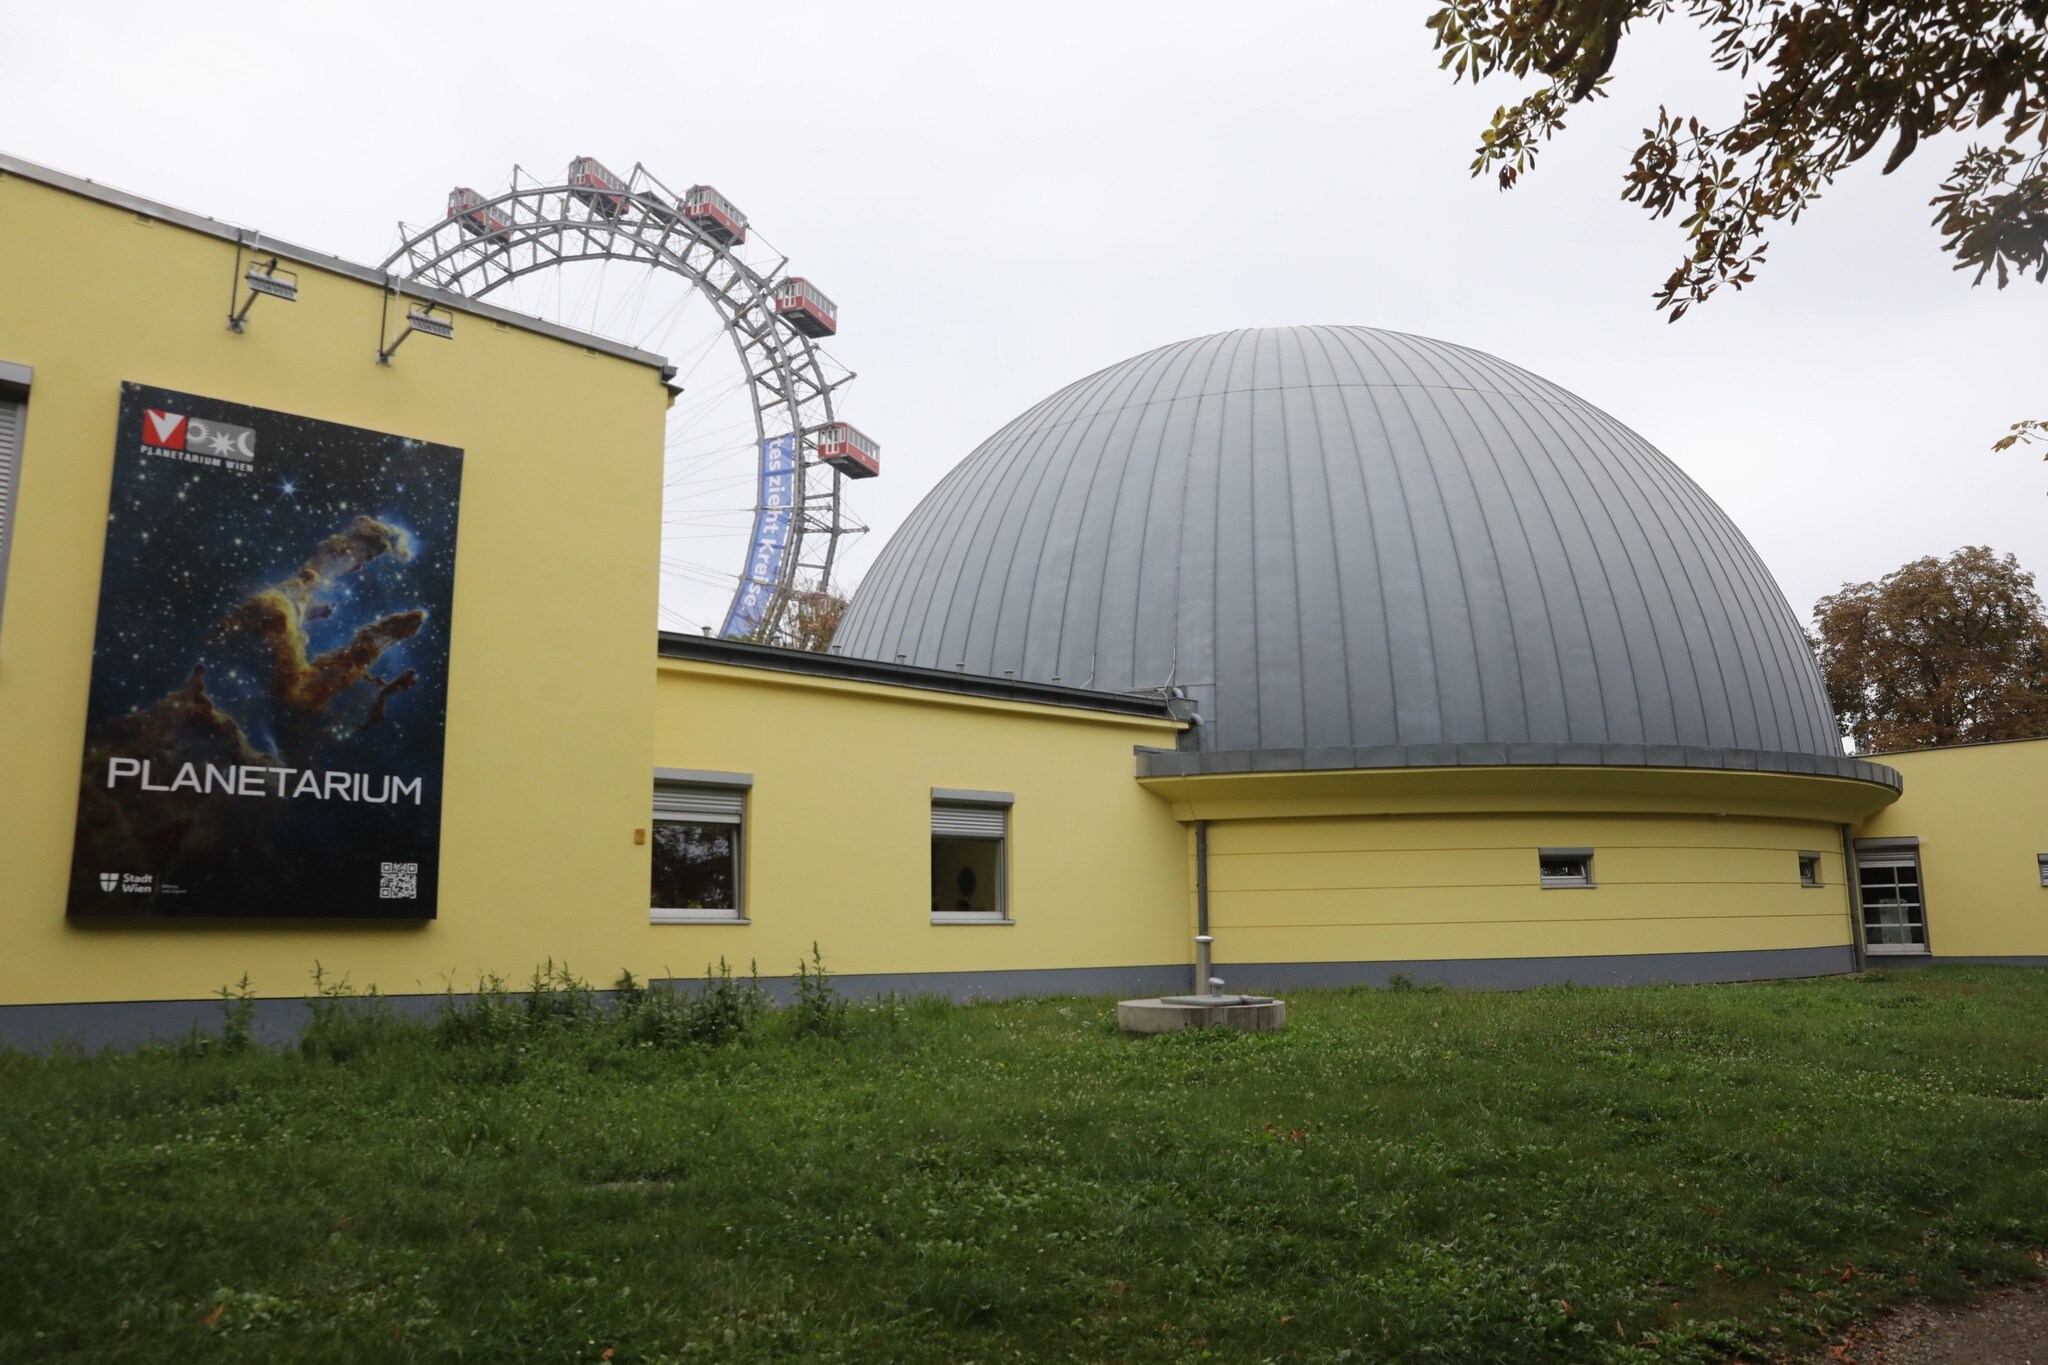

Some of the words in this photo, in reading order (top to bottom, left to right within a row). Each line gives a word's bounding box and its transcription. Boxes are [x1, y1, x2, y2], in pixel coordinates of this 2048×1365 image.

[140, 445, 222, 467] PLANETARIUM
[225, 460, 254, 473] WIEN
[763, 475, 786, 534] zieht
[107, 757, 423, 805] PLANETARIUM
[121, 883, 152, 893] Wien
[122, 873, 153, 883] Stadt
